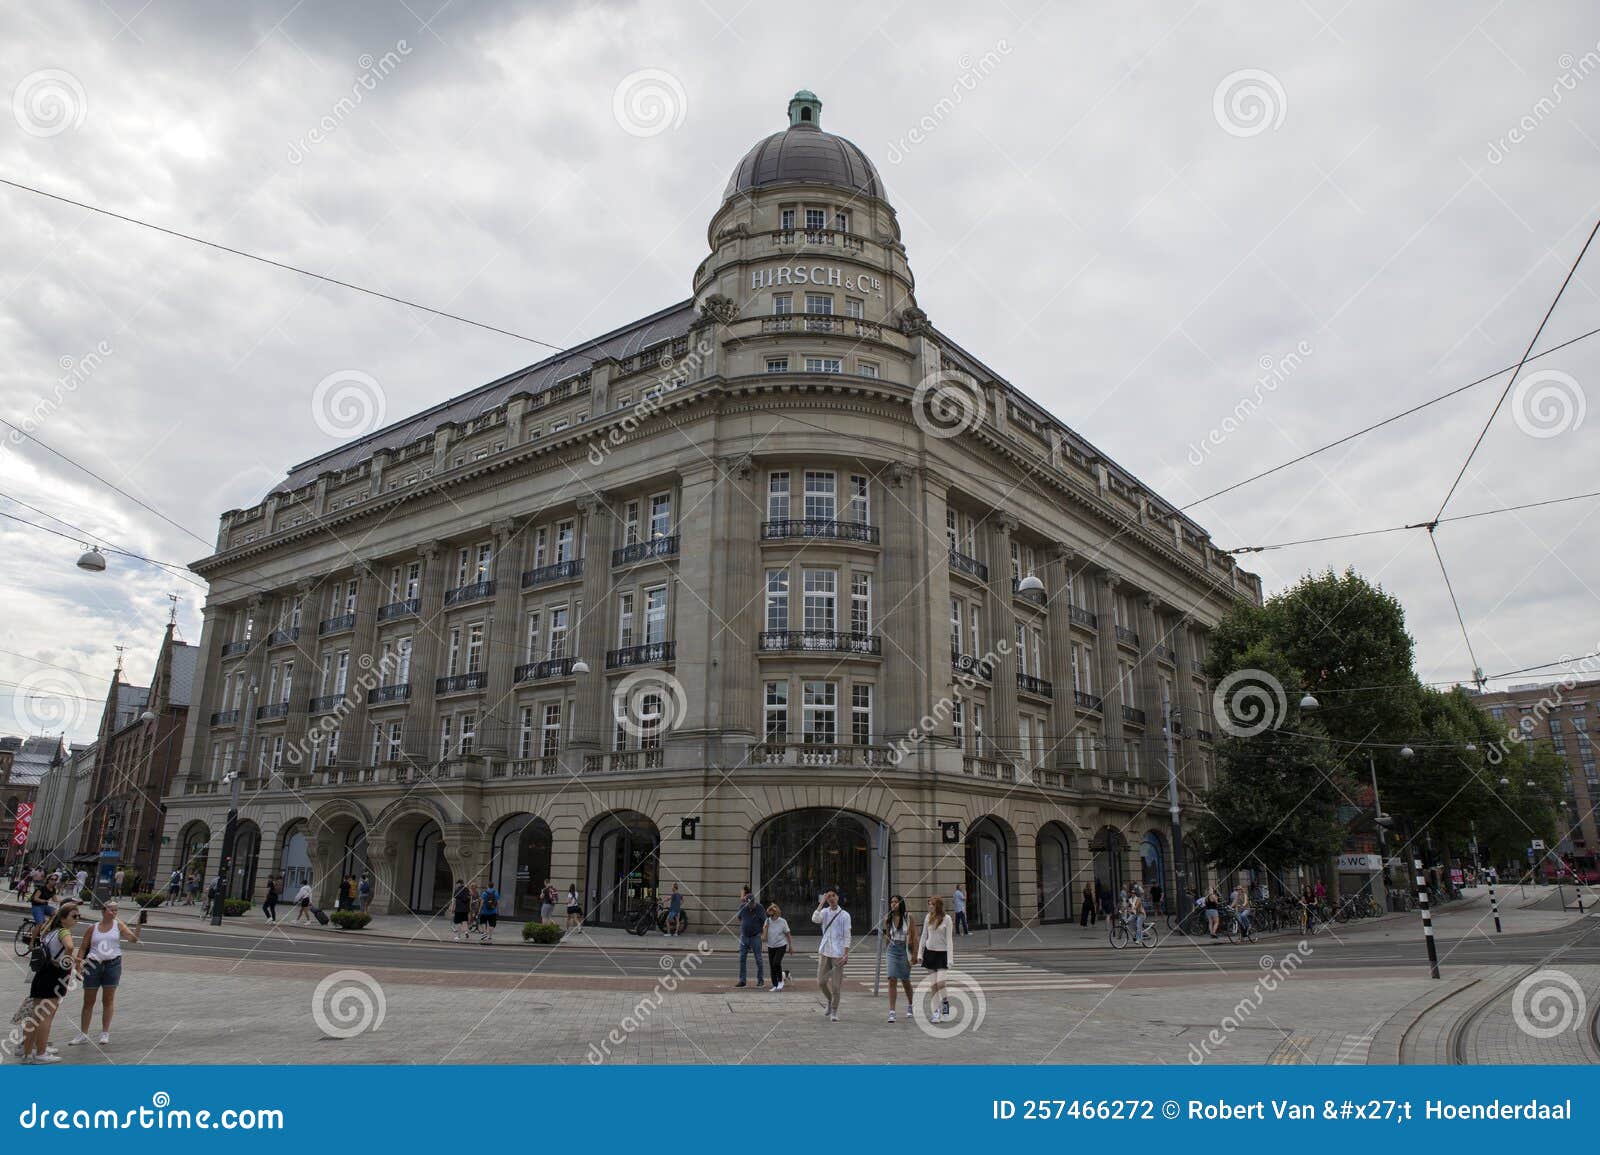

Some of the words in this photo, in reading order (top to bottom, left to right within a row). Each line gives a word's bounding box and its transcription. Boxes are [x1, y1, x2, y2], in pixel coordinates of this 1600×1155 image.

[752, 266, 842, 290] HIRSCH
[845, 277, 855, 290] &
[1348, 857, 1366, 865] WC
